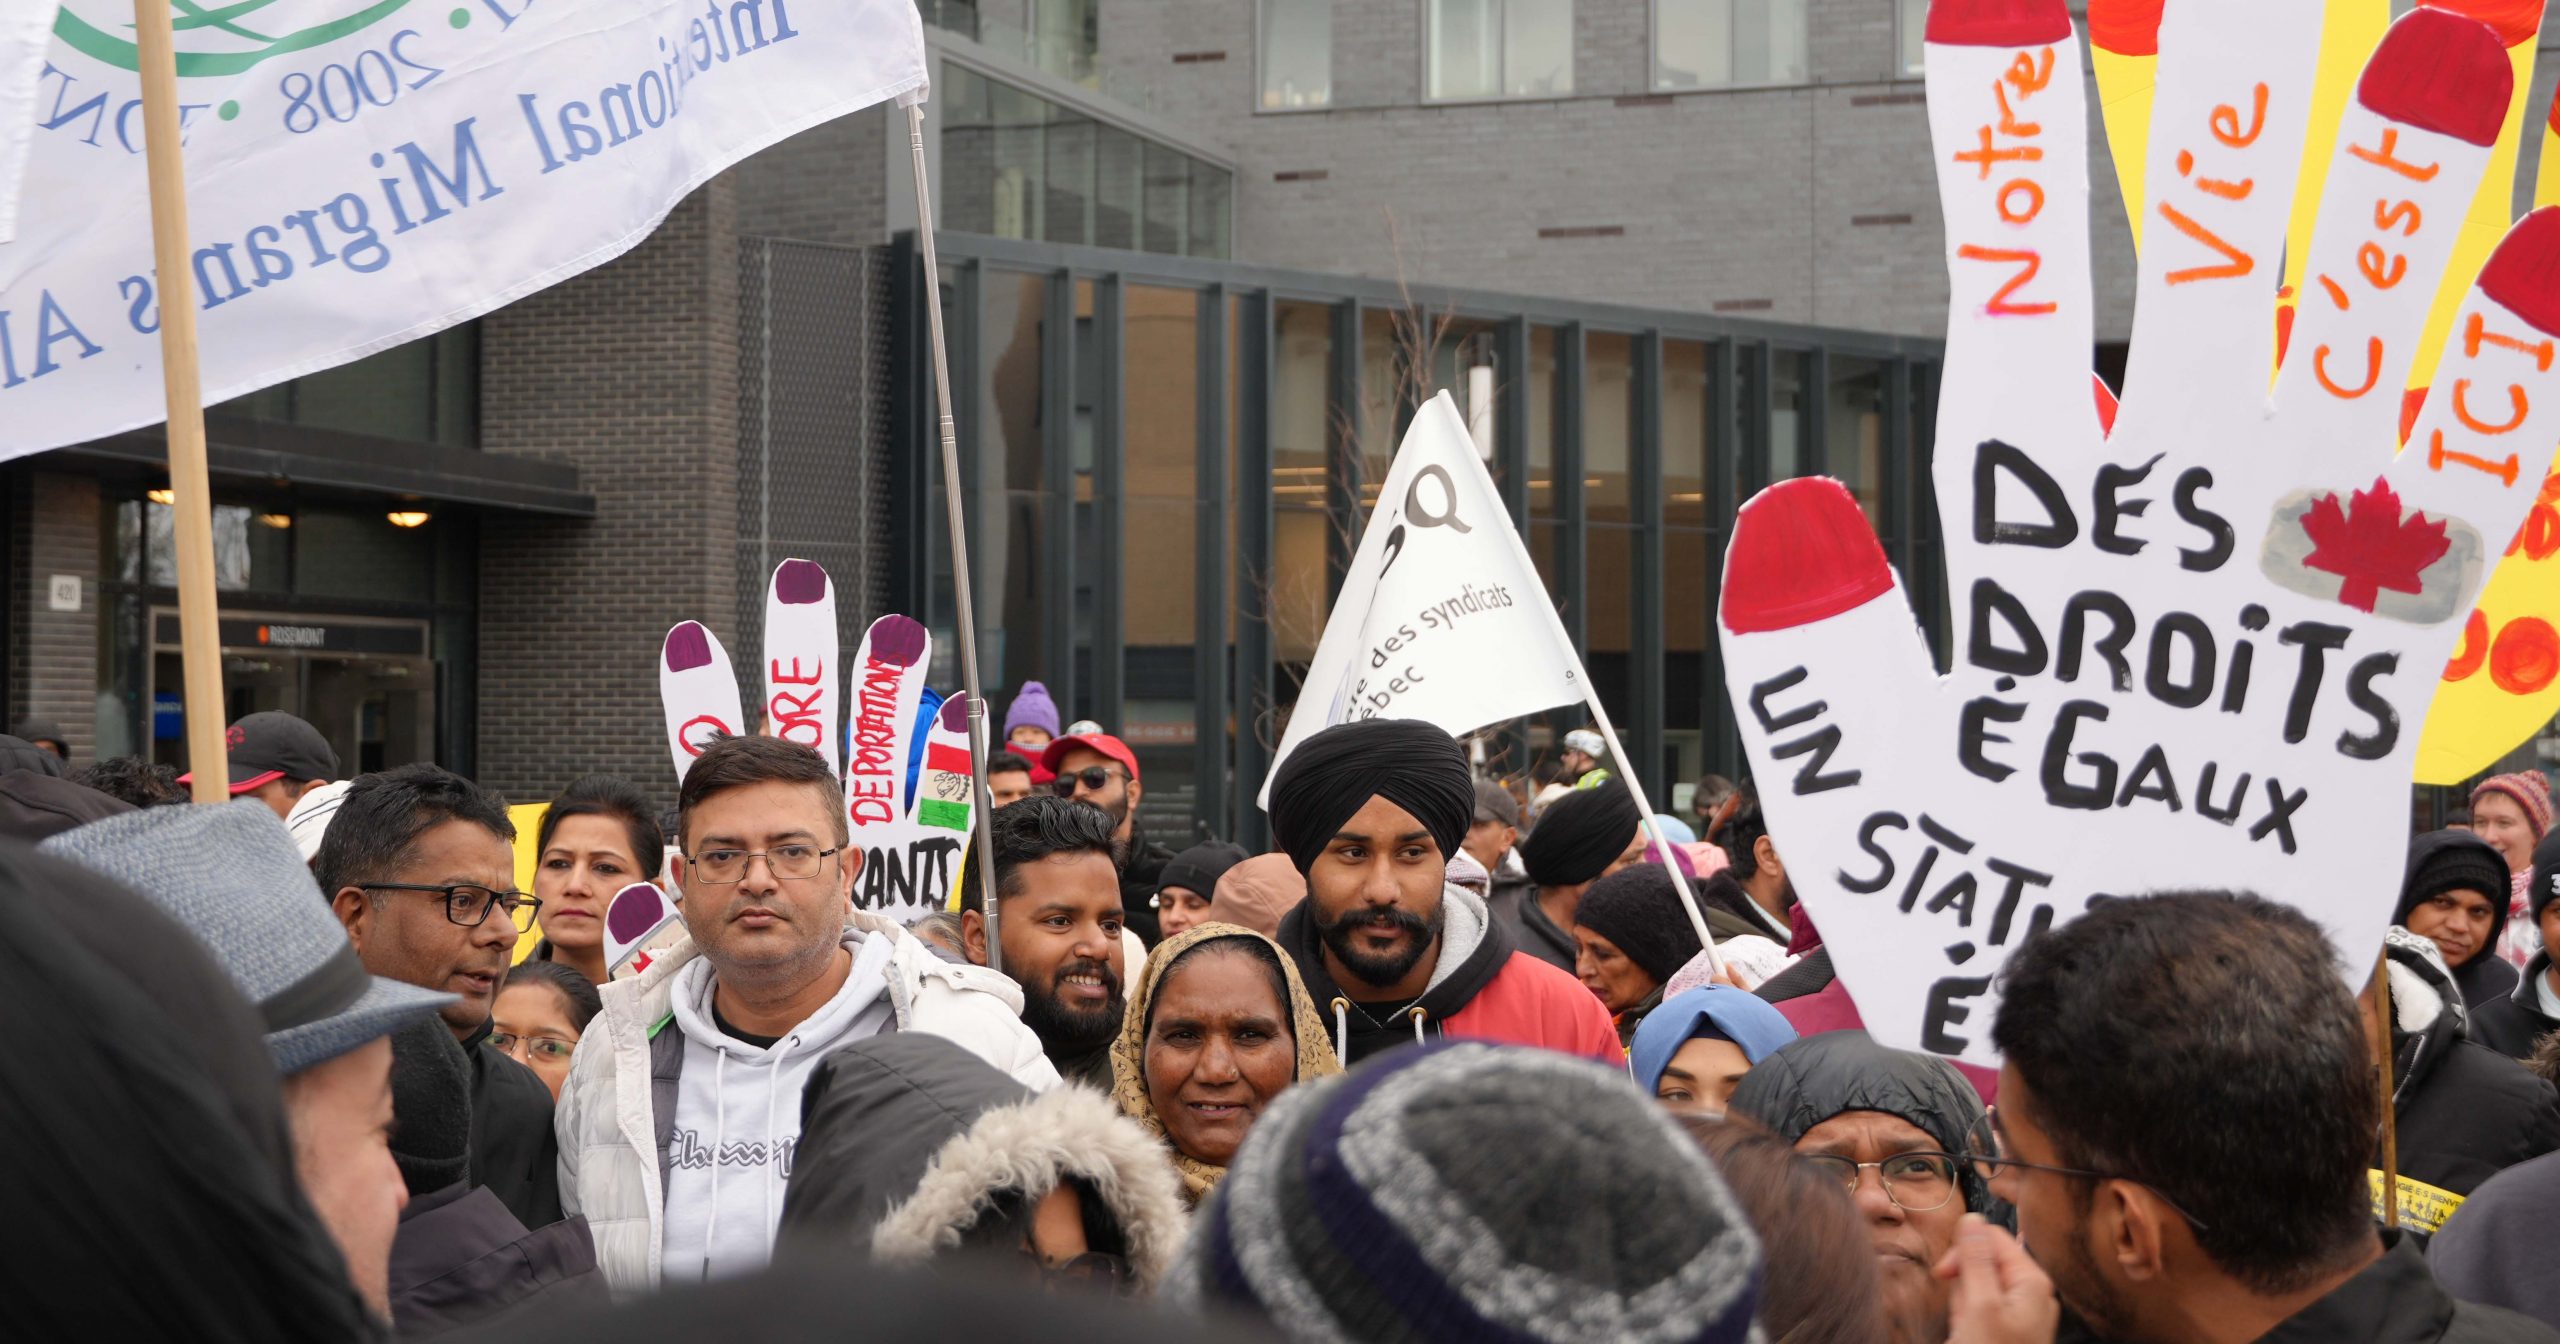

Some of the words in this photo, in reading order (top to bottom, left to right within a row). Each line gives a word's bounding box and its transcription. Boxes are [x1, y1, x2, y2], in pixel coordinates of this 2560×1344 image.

[1953, 46, 2057, 317] Notre
[2158, 81, 2270, 286] Vie
[2313, 128, 2440, 400] C'est
[2428, 312, 2554, 487] ICI
[1972, 439, 2236, 572] DES
[269, 625, 326, 647] ROSEMONT
[1360, 665, 1424, 721] ébec
[1371, 624, 1417, 669] des
[1419, 582, 1513, 630] syndicats
[770, 655, 824, 750] ORE
[1748, 664, 1863, 796] UN
[1958, 675, 2308, 855] ÉGAUX
[1836, 811, 2120, 948] STAT
